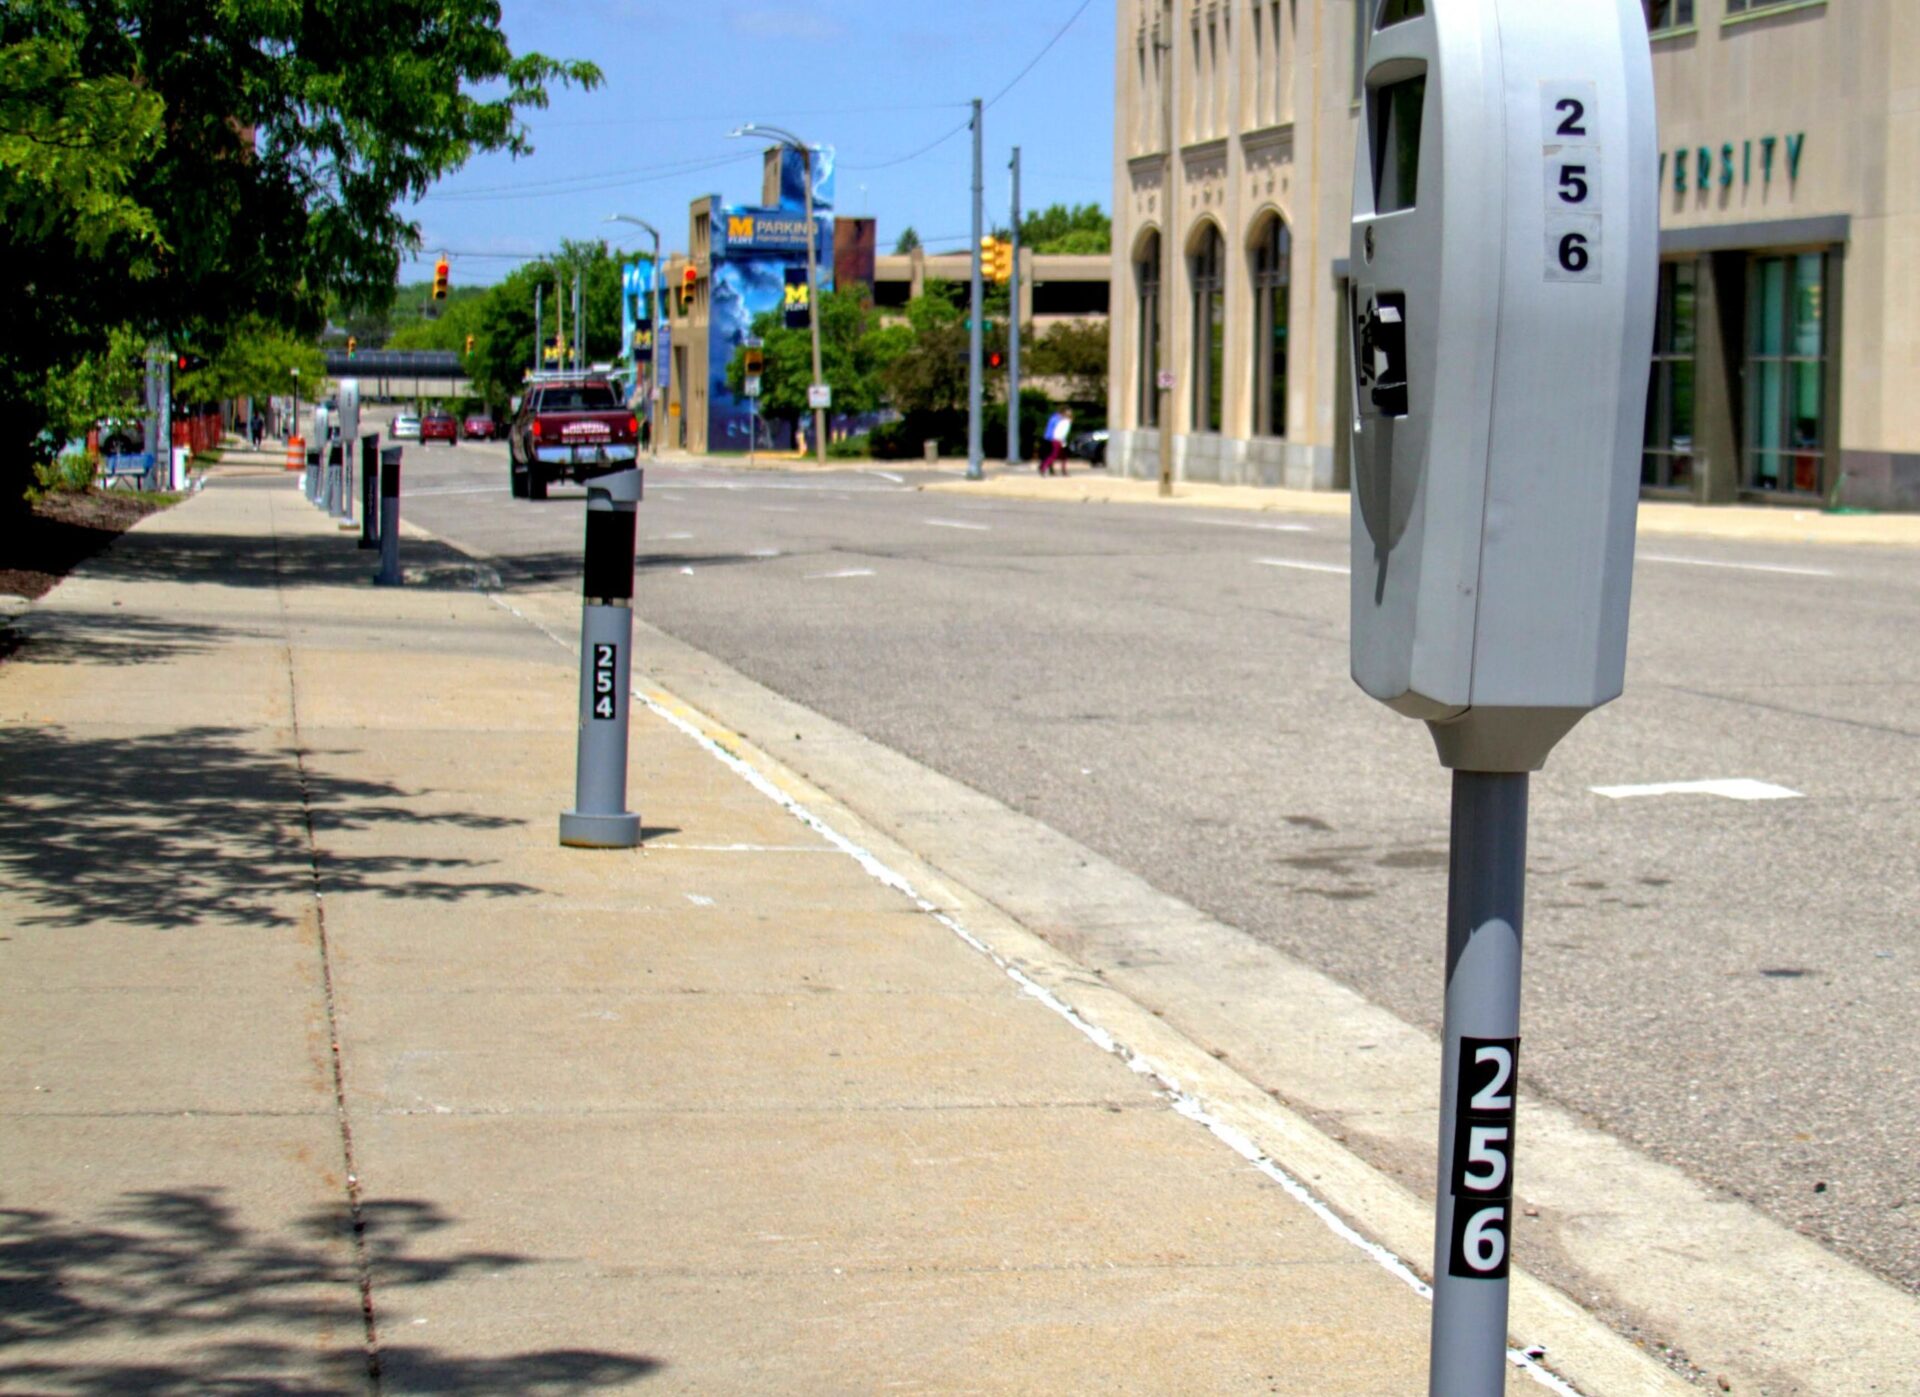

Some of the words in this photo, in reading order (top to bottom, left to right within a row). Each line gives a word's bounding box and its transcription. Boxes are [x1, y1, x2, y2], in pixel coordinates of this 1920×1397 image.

[727, 215, 754, 236] M
[785, 282, 808, 304] M
[596, 645, 613, 718] 254
[1463, 1046, 1512, 1272] 256
